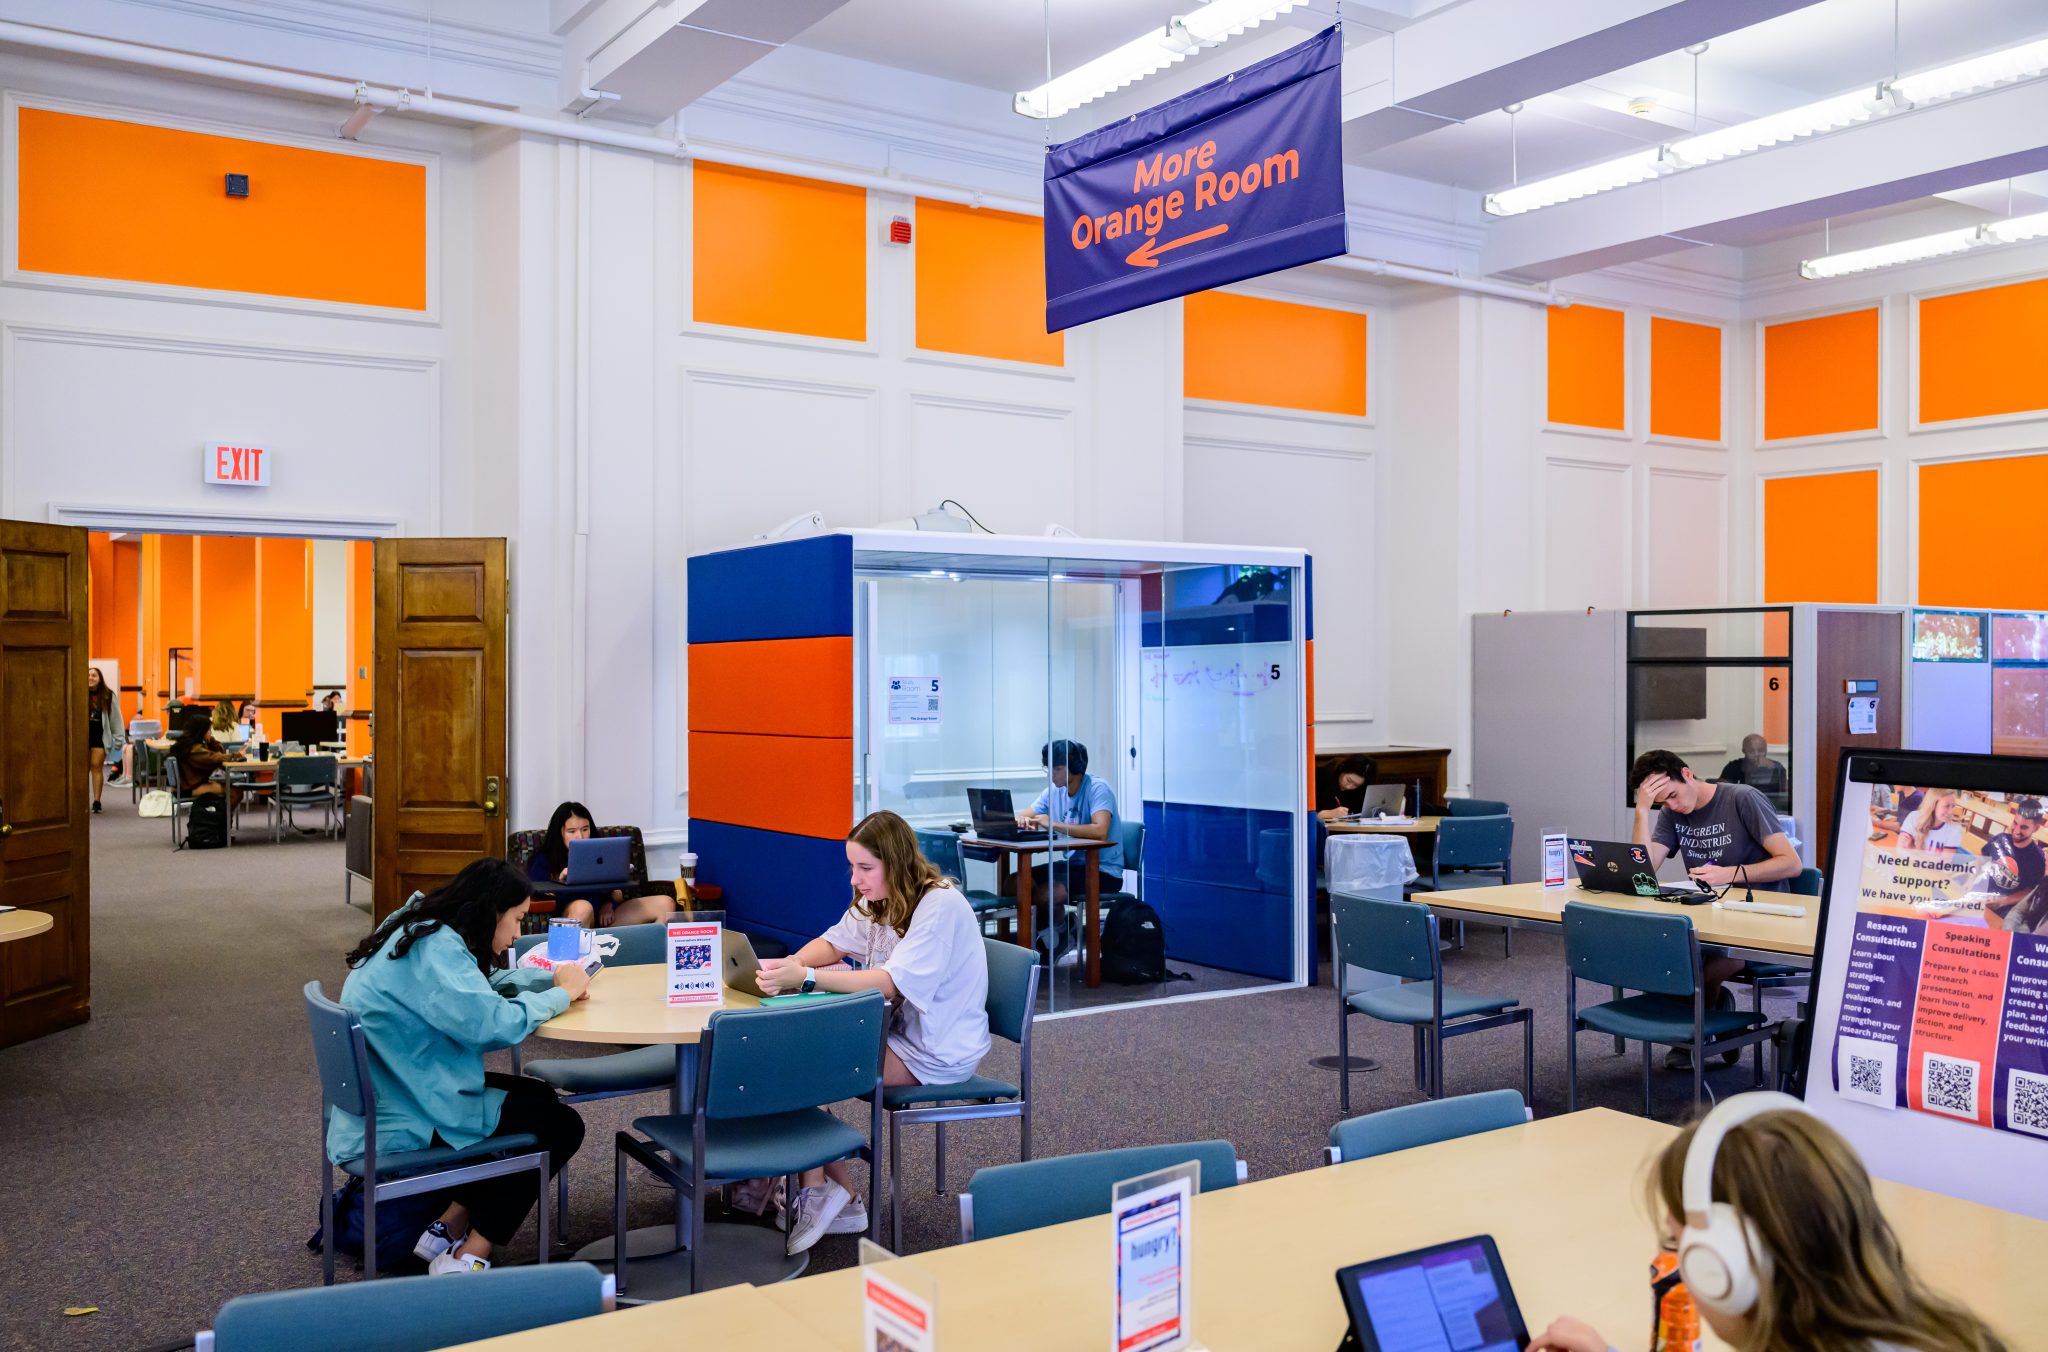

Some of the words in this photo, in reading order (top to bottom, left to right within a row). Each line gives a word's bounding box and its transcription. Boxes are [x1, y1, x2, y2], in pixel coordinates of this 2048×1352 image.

[1133, 140, 1217, 194] More
[1071, 190, 1185, 250] Orange
[1195, 149, 1299, 211] Room
[217, 446, 263, 481] EXIT
[1270, 664, 1281, 680] 5
[931, 680, 939, 692] 5
[1769, 677, 1779, 691] 6
[1869, 700, 1876, 709] 6
[1680, 834, 1732, 848] INDUSTRIES
[1687, 849, 1707, 859] Since
[1877, 854, 1909, 867] Need
[1913, 859, 1977, 874] academic
[1892, 874, 1950, 889] support?
[1862, 888, 1877, 898] We
[1880, 889, 1906, 901] have
[1866, 920, 1908, 934] Research
[1856, 932, 1918, 949] Consultations
[1945, 931, 1991, 947] Speaking
[1853, 949, 1872, 958] Learn
[1872, 952, 1895, 962] about
[1931, 943, 2001, 960] Consultations
[1851, 961, 1873, 969] search
[1924, 960, 1956, 971] Prepare
[1958, 965, 1970, 973] for
[1979, 969, 1999, 978] class
[1849, 971, 1885, 984] strategies,
[1933, 974, 1969, 985] research
[2011, 973, 2048, 986] Improve
[1847, 982, 1870, 991] source
[2010, 986, 2042, 999] writing
[1845, 993, 1885, 1006] evaluation,
[1886, 1000, 1902, 1008] and
[1919, 994, 1940, 1003] learn
[1942, 997, 1960, 1006] how
[1961, 1001, 1970, 1009] to
[1977, 993, 1993, 1001] and
[2008, 998, 2036, 1009] create
[1843, 1004, 1862, 1012] more
[1918, 1006, 1951, 1017] improve
[1841, 1014, 1881, 1027] strengthen
[1882, 1022, 1901, 1030] your
[2006, 1009, 2028, 1020] plan,
[2030, 1014, 2048, 1023] and
[1840, 1026, 1871, 1036] research
[1872, 1031, 1897, 1042] paper.
[1948, 1023, 1964, 1031] and
[2005, 1020, 2045, 1035] feedback
[1914, 1029, 1954, 1042] structure.
[2003, 1033, 2024, 1042] your
[1130, 1227, 1177, 1261] hungry?
